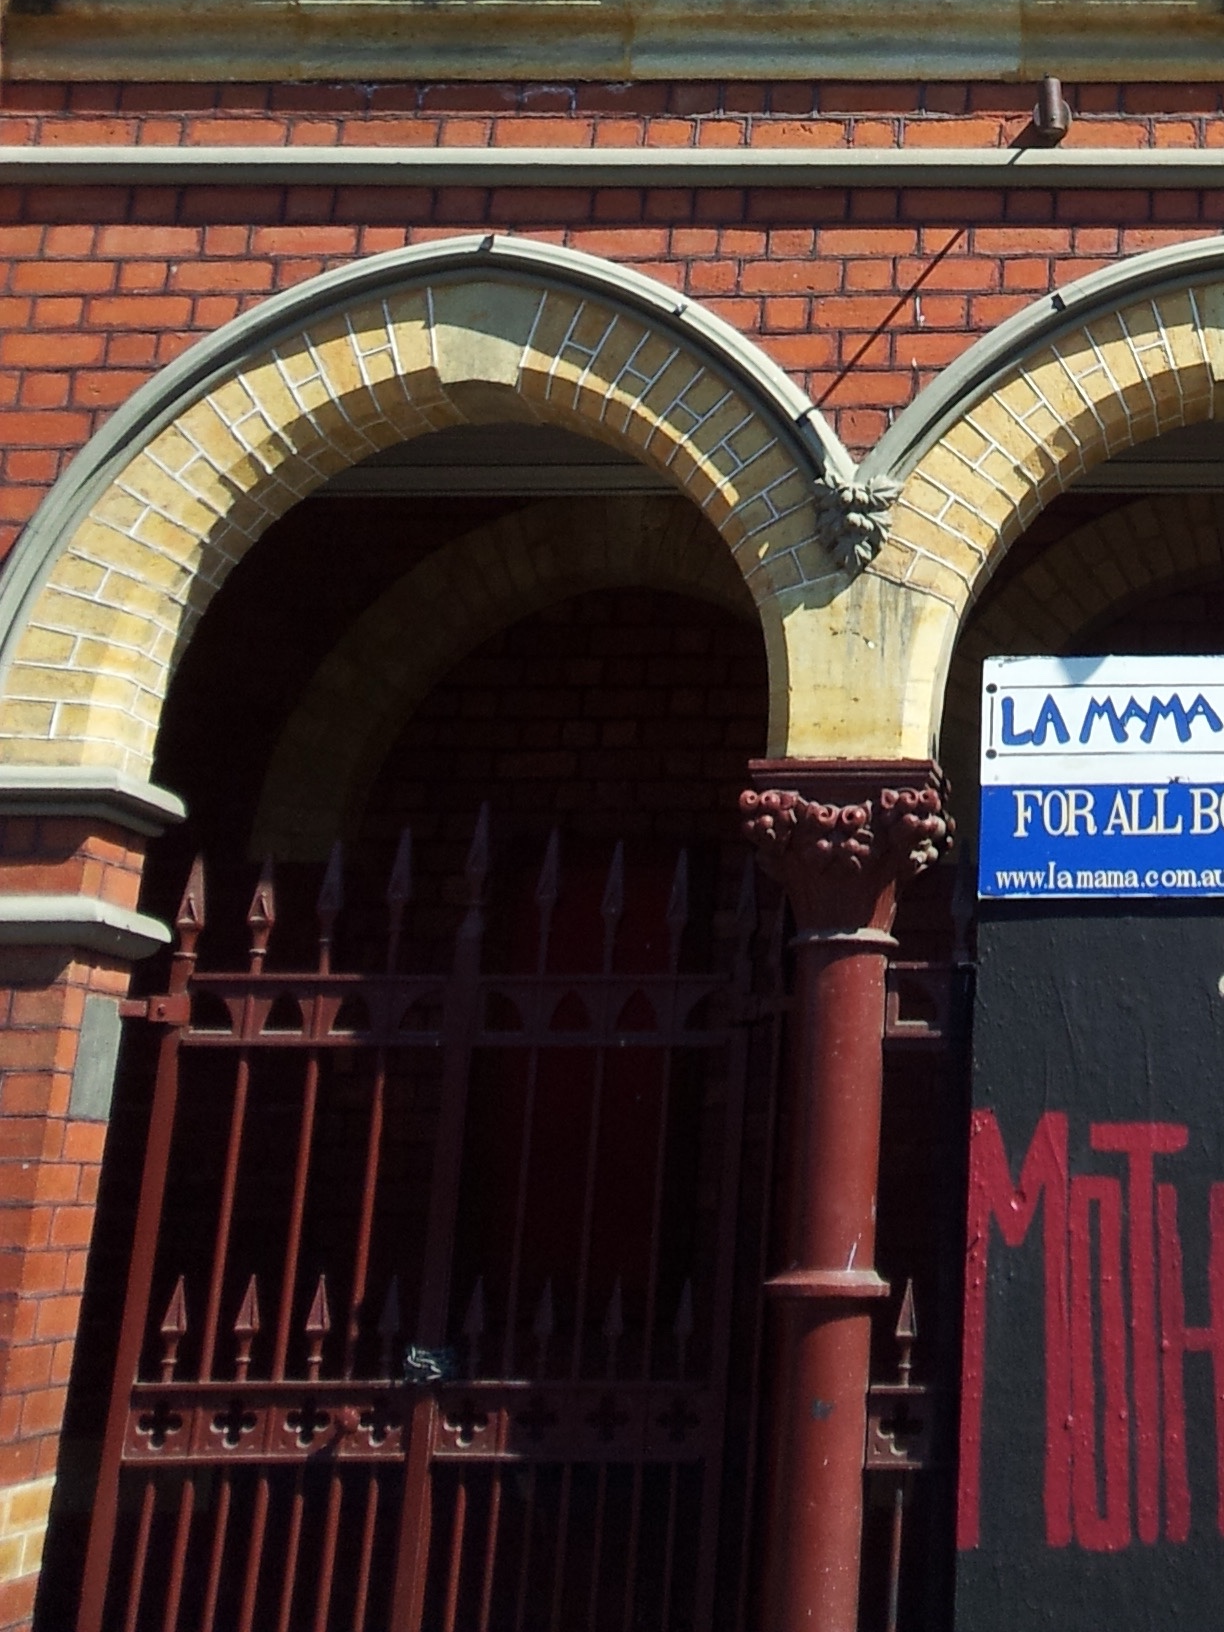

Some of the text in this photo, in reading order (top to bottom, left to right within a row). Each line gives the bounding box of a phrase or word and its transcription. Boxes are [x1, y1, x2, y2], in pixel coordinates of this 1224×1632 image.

[1001, 692, 1071, 746] LA
[1079, 692, 1224, 744] MAMA
[1012, 789, 1097, 837] FOR
[1103, 788, 1183, 836] ALL
